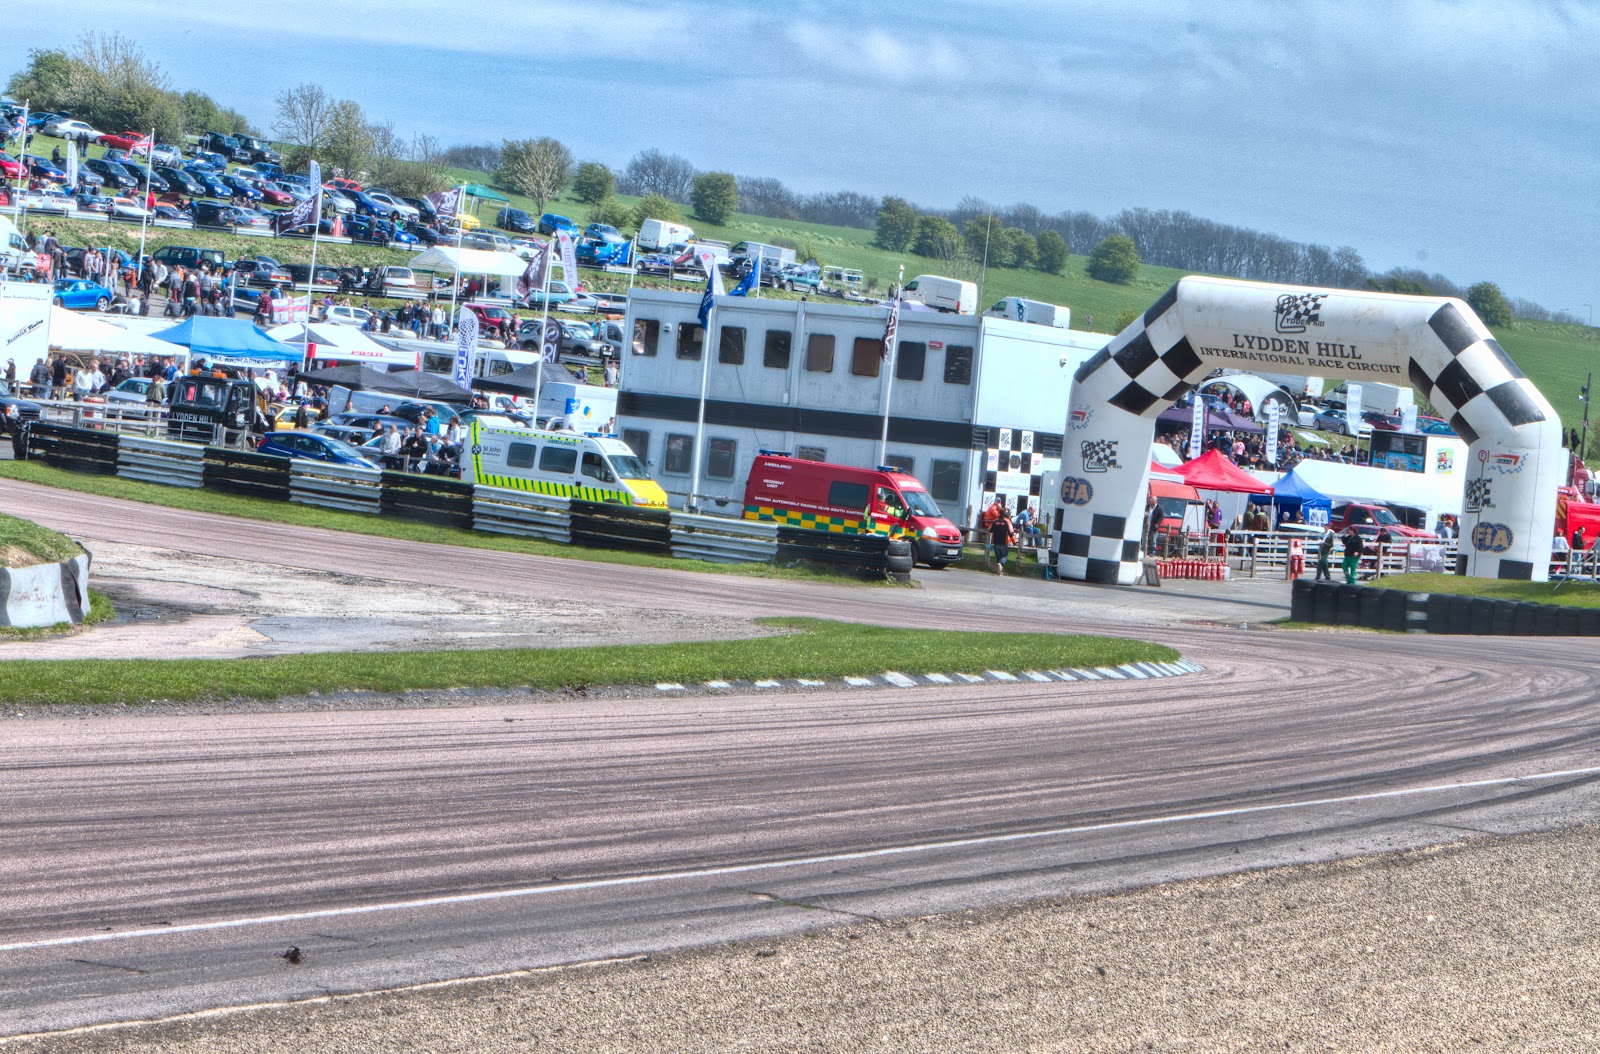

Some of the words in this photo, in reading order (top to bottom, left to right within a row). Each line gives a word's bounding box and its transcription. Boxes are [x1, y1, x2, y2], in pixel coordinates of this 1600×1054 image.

[1232, 334, 1309, 355] LYDDEN
[1316, 342, 1362, 360] HILL
[1200, 347, 1304, 366] INTERNATIONAL
[1309, 358, 1344, 369] RACE
[1347, 361, 1401, 374] CIRCUIT
[172, 411, 198, 421] LYDDEN
[199, 415, 213, 423] HILL
[547, 439, 576, 447] AMBULANCE
[763, 462, 792, 470] AMBULANCE
[772, 498, 800, 507] AUTOMOBILE
[800, 502, 818, 510] RACING
[870, 511, 888, 519] CENTRE
